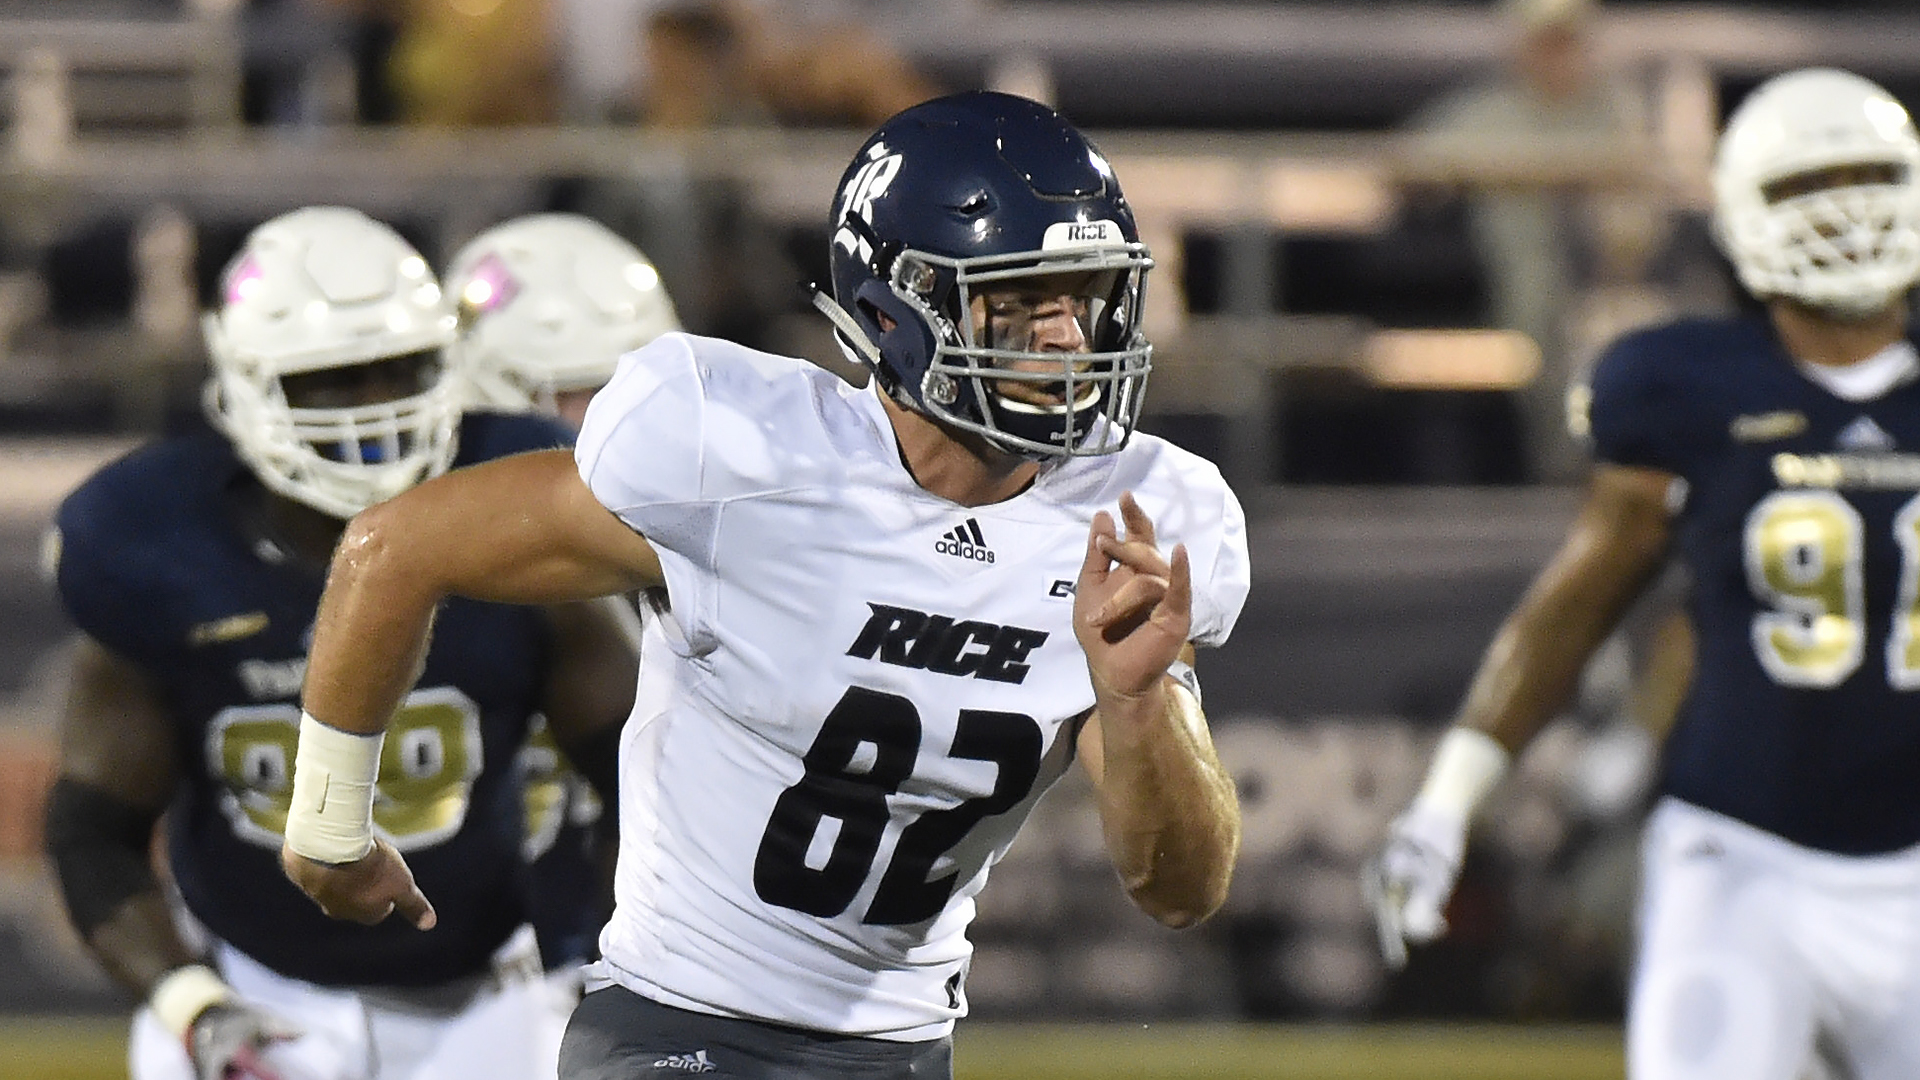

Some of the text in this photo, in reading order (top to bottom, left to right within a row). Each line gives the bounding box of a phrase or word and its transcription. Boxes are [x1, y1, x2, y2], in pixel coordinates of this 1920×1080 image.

[1067, 224, 1107, 241] RICE
[935, 541, 995, 564] adidas
[845, 601, 1050, 685] RICE
[753, 685, 1043, 924] 82
